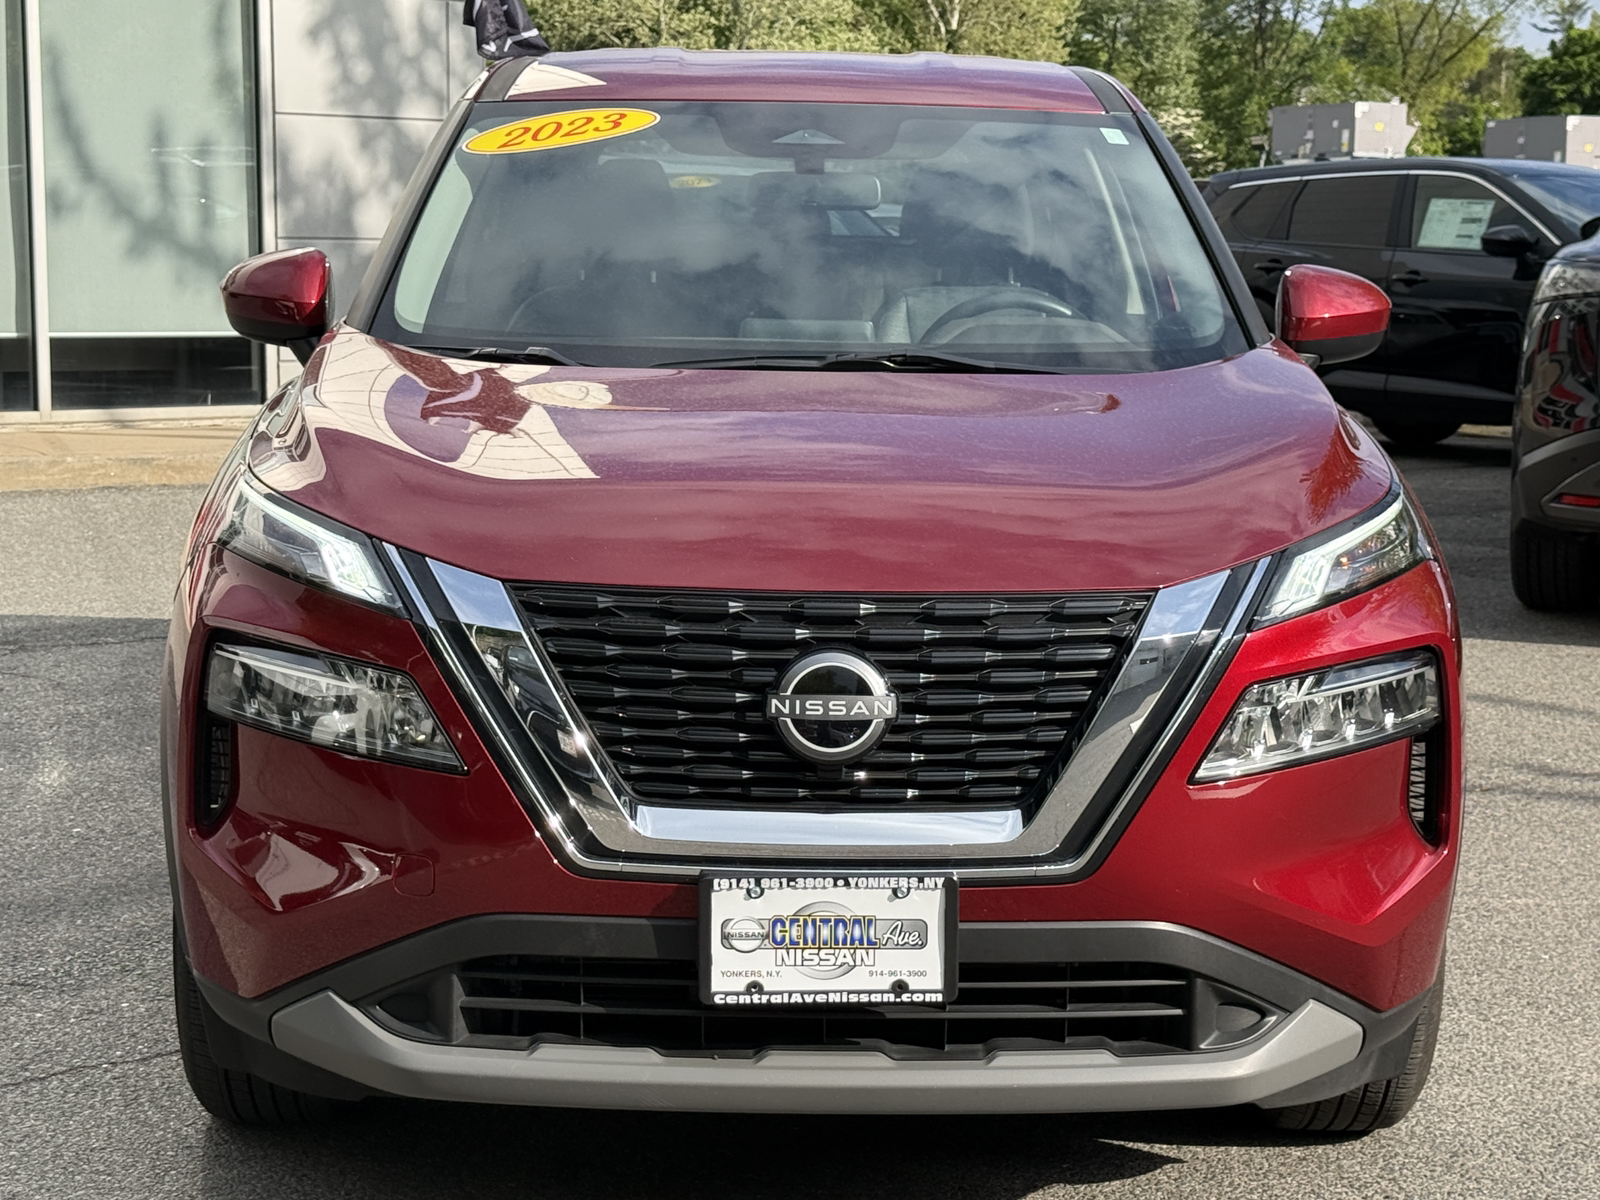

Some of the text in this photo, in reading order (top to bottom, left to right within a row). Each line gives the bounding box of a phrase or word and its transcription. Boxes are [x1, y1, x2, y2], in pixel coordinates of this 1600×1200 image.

[497, 112, 627, 149] 2023
[771, 698, 892, 716] NISSAN
[761, 878, 834, 889] 961-3900
[770, 915, 924, 949] CENTRAL Ave.
[775, 948, 876, 967] NISSAN
[720, 970, 782, 978] YONKERS, N.Y.
[713, 992, 943, 1004] CentralAveNissan.com
